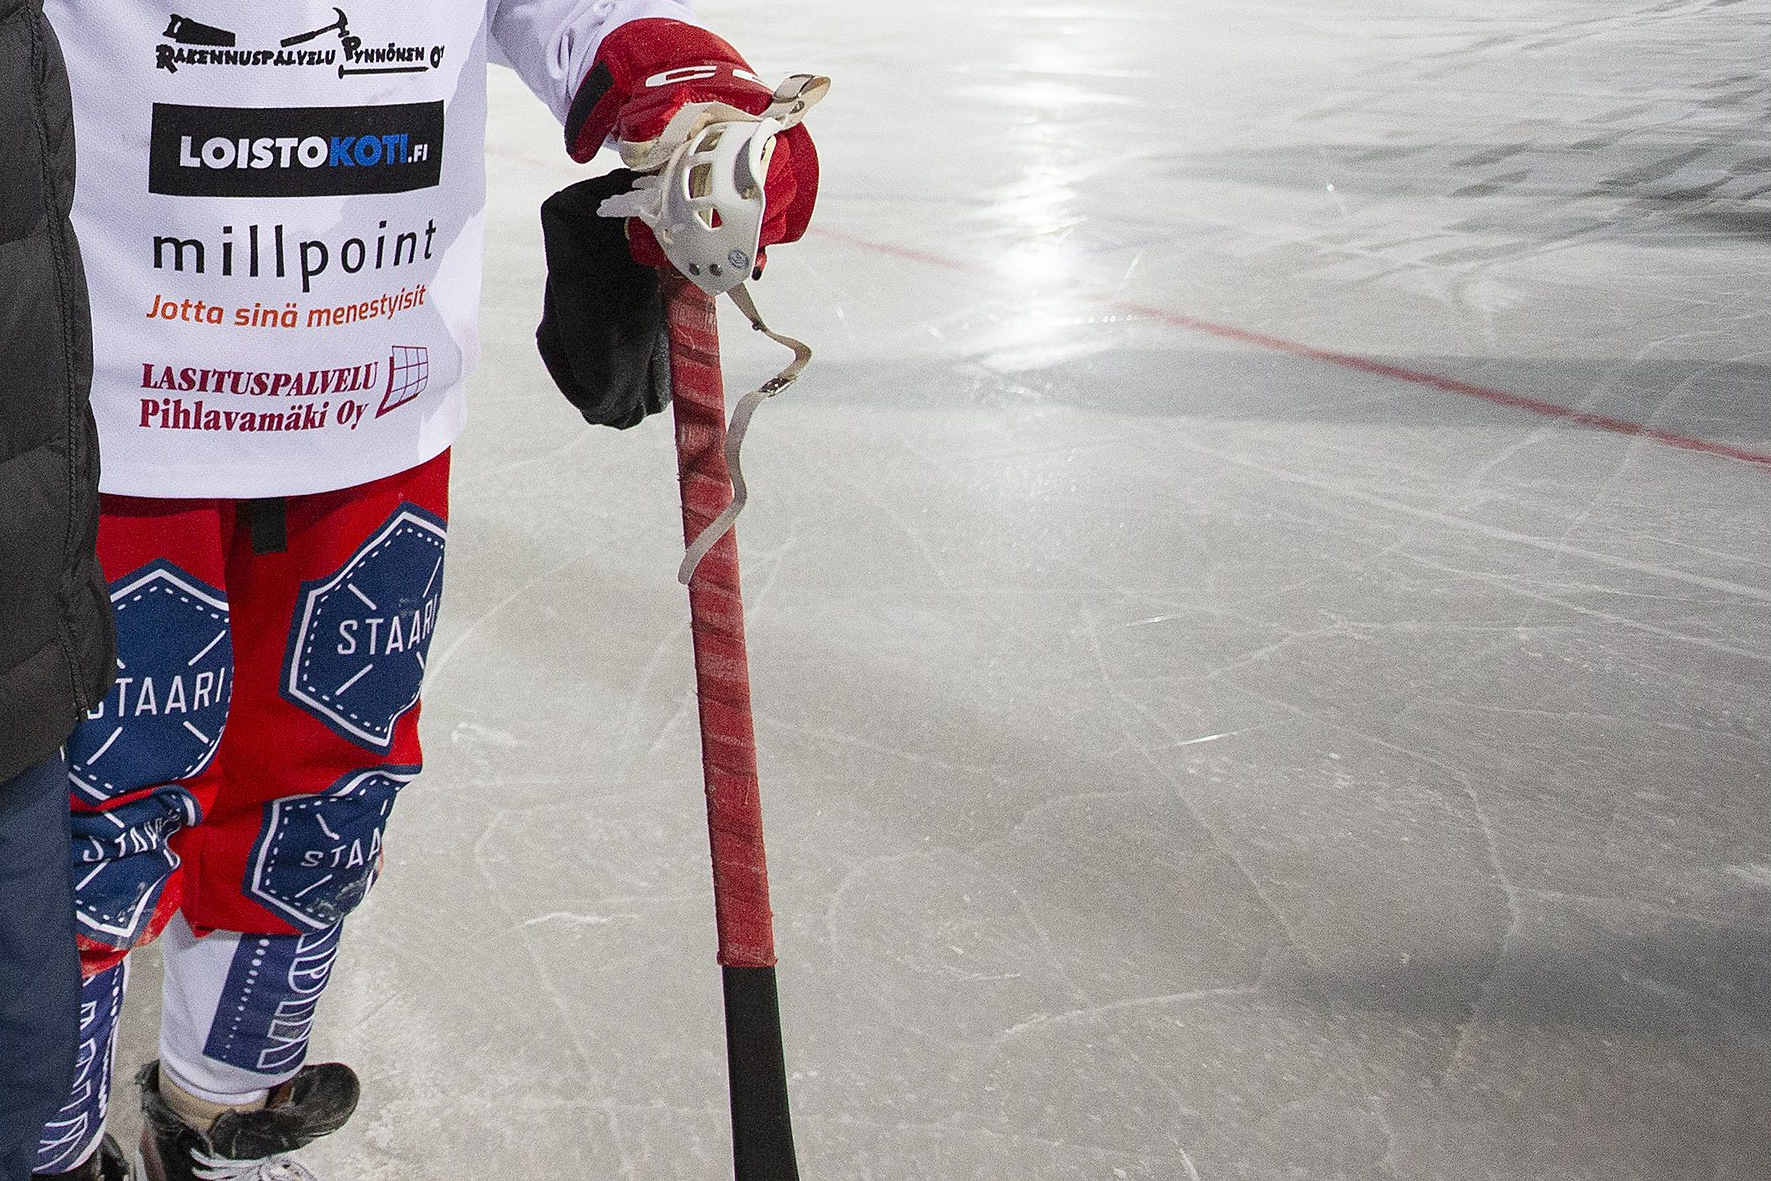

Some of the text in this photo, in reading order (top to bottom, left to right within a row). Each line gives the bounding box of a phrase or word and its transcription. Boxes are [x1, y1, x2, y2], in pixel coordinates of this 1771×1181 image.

[155, 43, 337, 74] RAKENNUSPALVELU
[178, 133, 429, 170] LOISTOKOTI.FI
[152, 218, 437, 294] millpoint
[146, 283, 427, 328] Jotta sinä menestyisit
[139, 361, 379, 397] LASITUSPALVELU
[138, 397, 370, 432] Pihlavamäki Oy
[337, 592, 438, 655] STAARI
